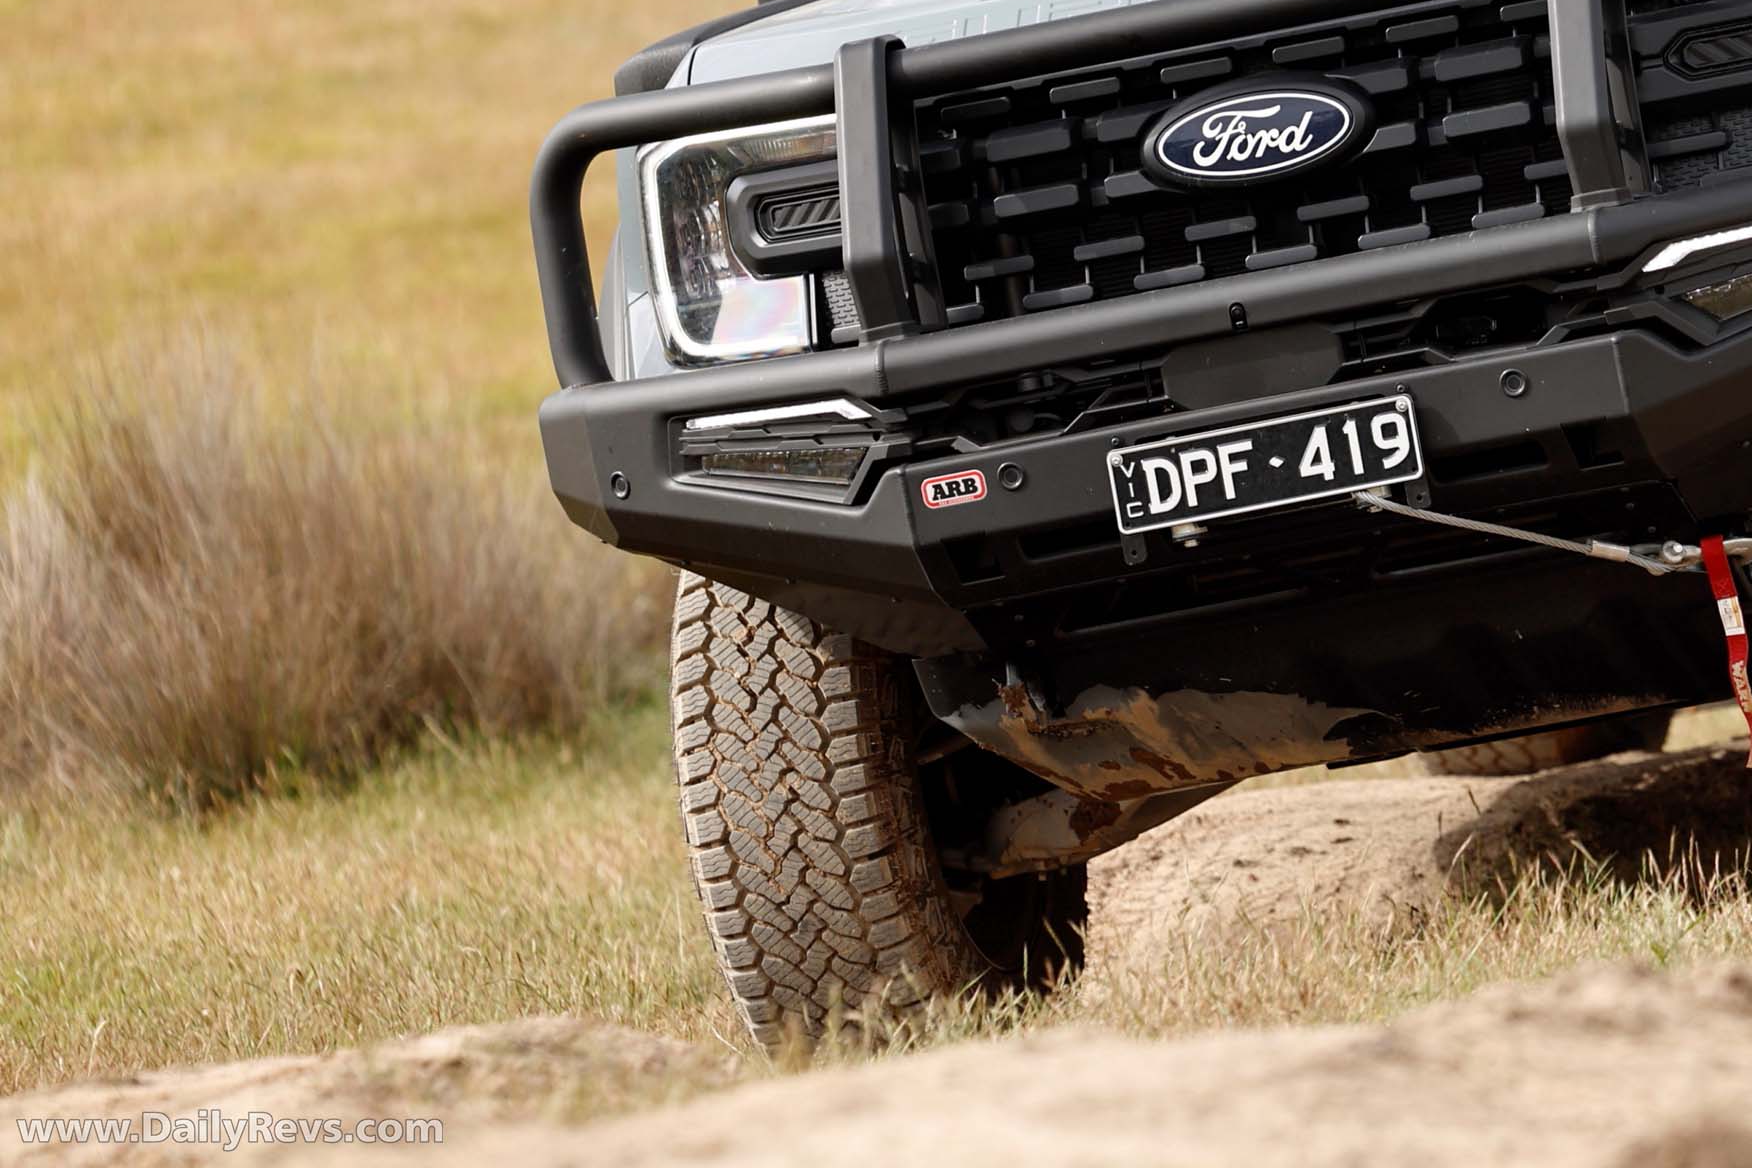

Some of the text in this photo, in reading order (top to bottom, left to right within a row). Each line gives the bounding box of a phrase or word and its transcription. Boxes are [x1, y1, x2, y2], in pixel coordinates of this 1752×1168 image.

[1192, 104, 1314, 167] Ford
[931, 477, 979, 501] ARB
[1119, 461, 1145, 519] VIC
[1141, 412, 1411, 515] DPF 419
